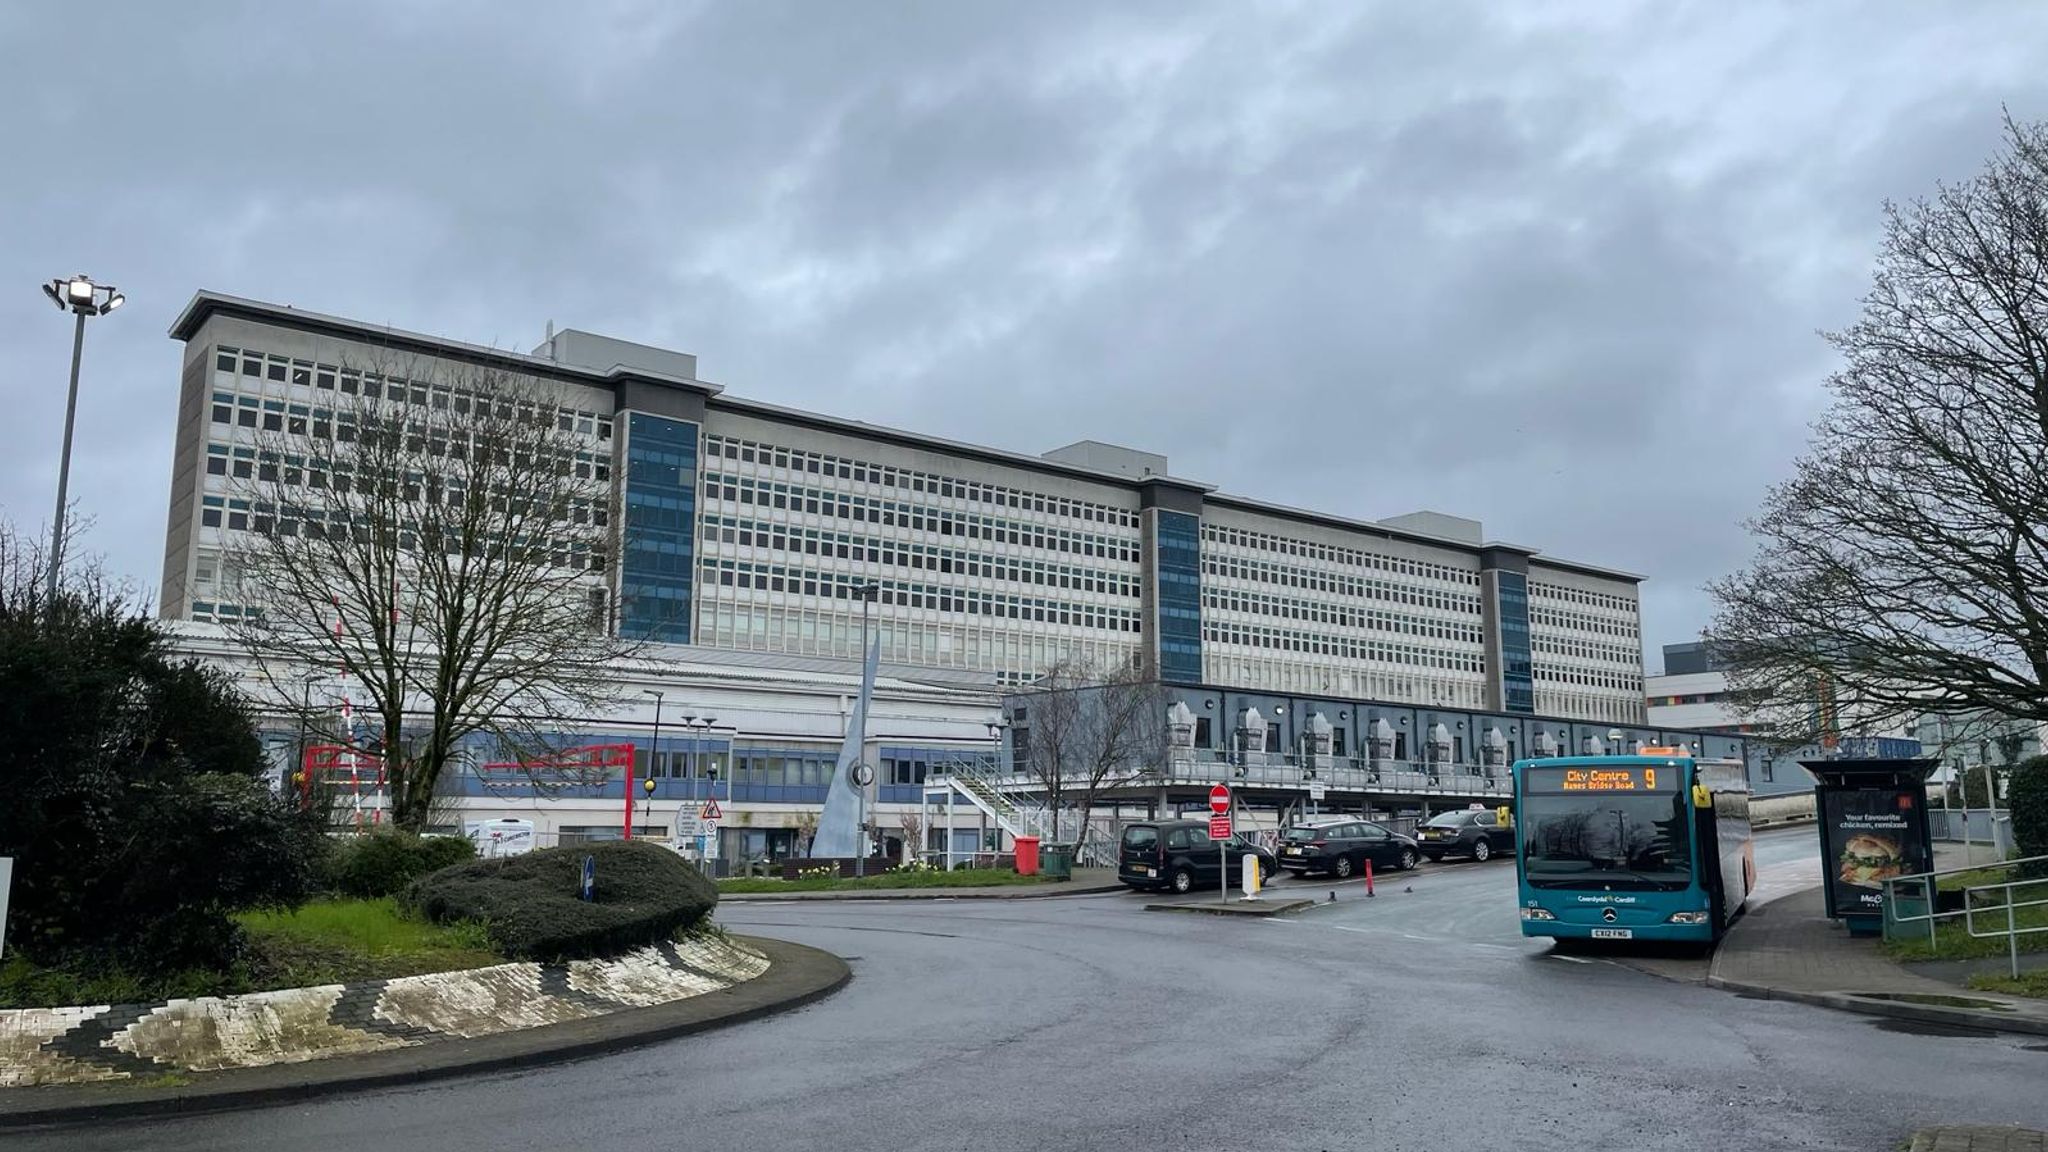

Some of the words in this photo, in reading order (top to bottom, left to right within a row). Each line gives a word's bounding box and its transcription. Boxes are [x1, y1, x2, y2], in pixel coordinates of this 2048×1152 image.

[1567, 770, 1588, 781] City
[1590, 769, 1630, 781] Centre
[1645, 768, 1656, 789] 9
[1845, 813, 1864, 821] Your
[1864, 813, 1901, 821] favourite
[1839, 821, 1874, 829] chicken,
[1874, 821, 1908, 829] remixed
